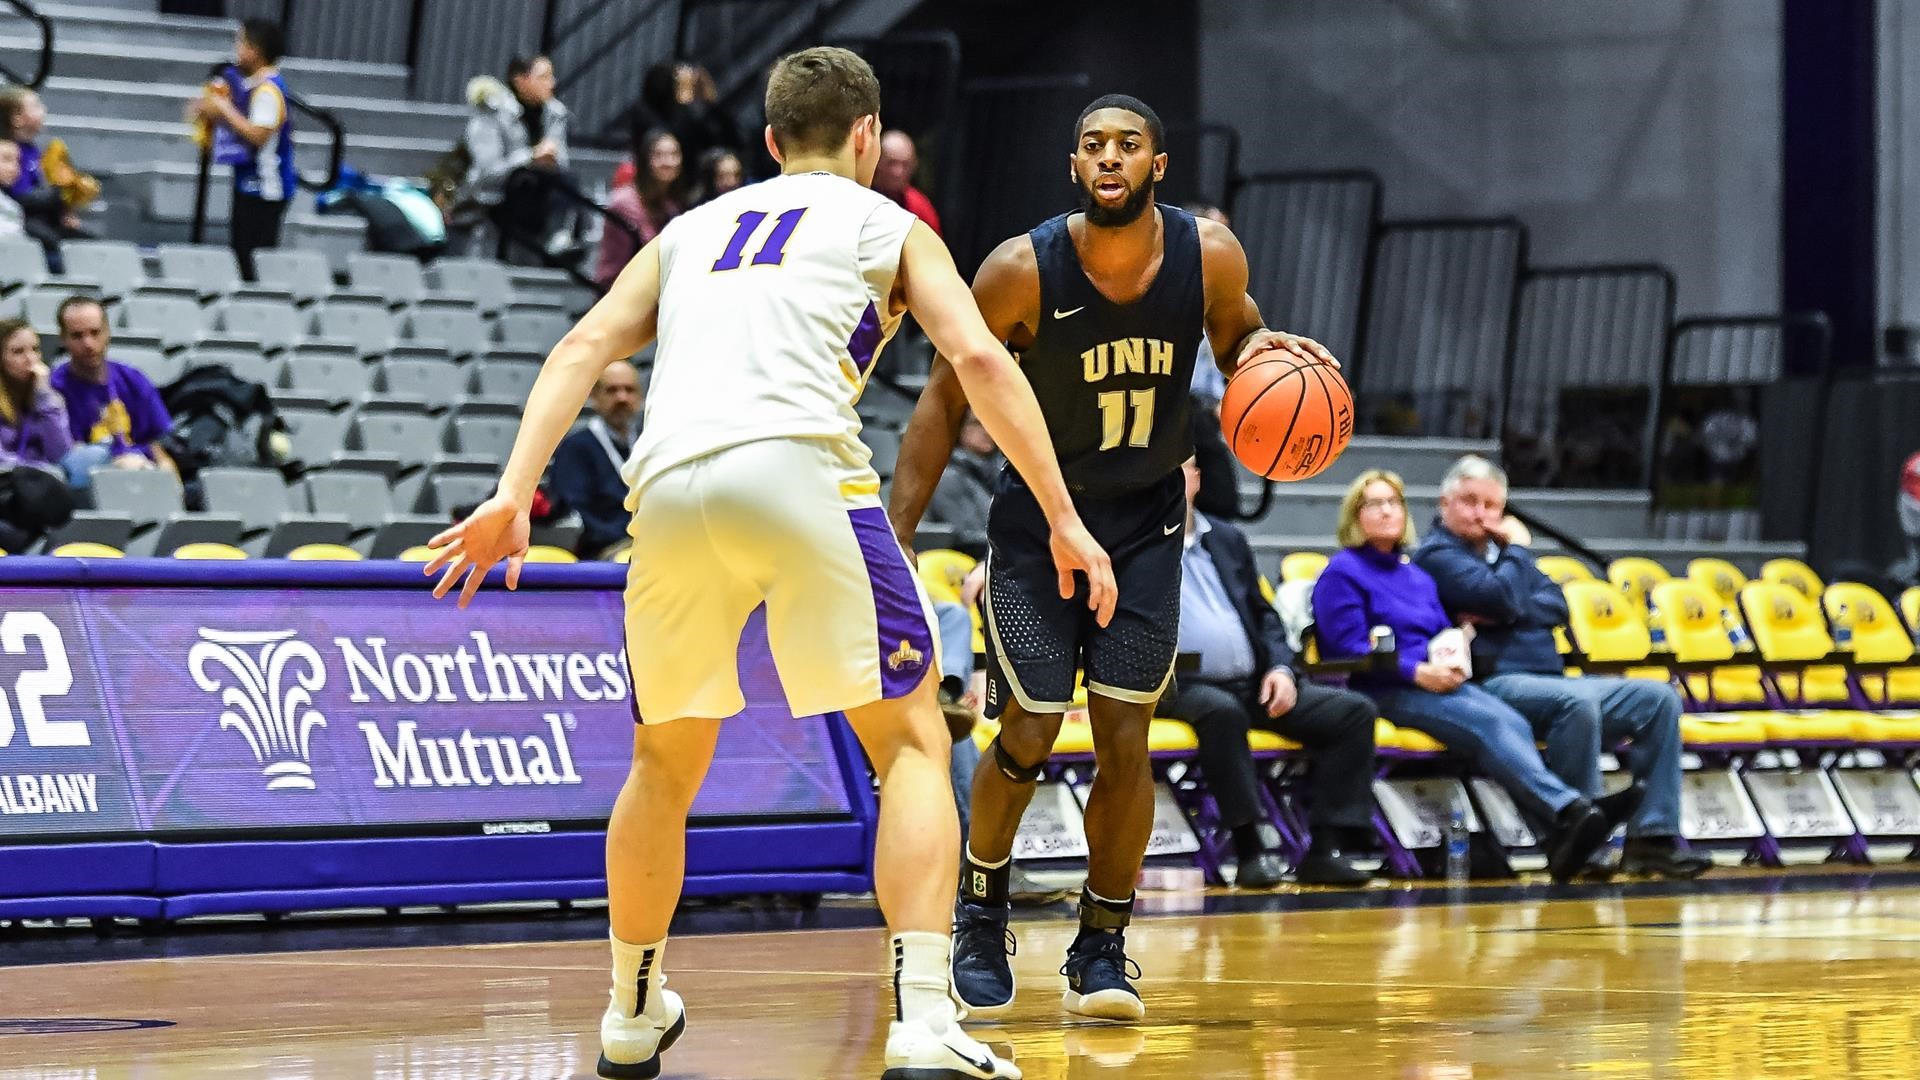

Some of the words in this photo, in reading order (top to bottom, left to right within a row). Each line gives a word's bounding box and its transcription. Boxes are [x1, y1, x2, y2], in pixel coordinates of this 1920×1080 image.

[710, 206, 809, 273] 11
[1080, 337, 1174, 383] UNH
[1098, 387, 1155, 451] 11
[0, 611, 92, 747] 2
[358, 712, 582, 788] Mutual
